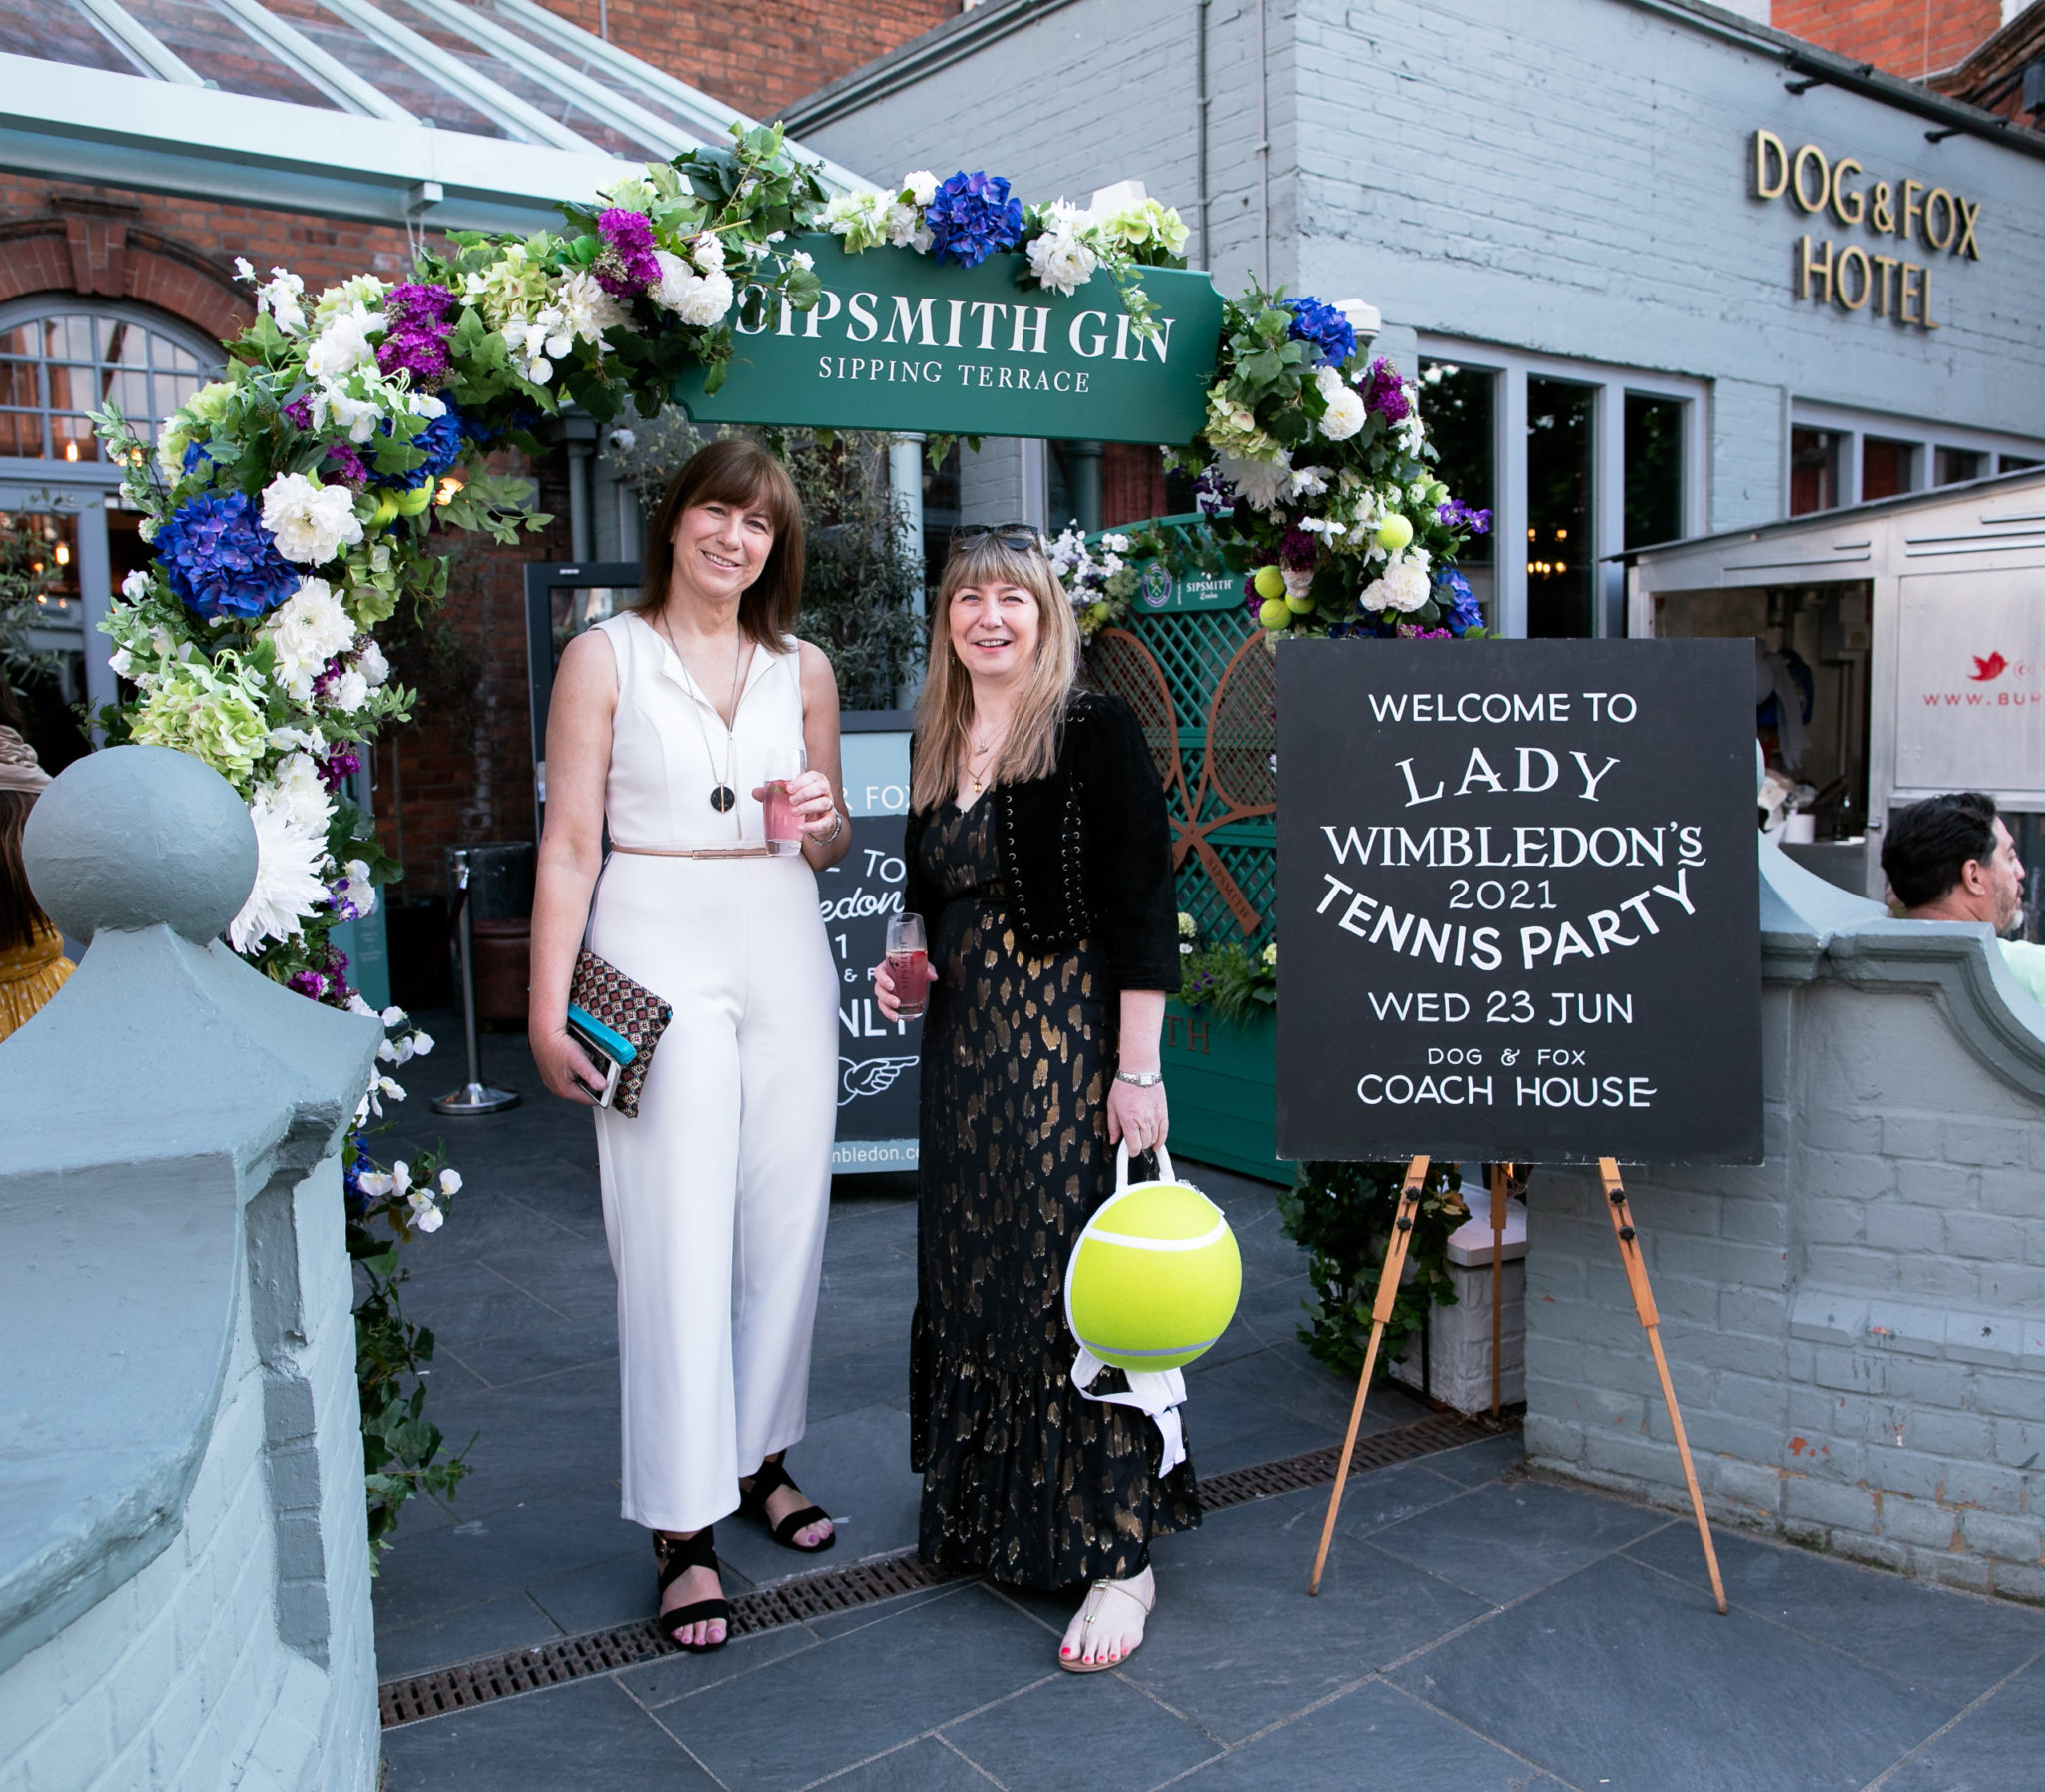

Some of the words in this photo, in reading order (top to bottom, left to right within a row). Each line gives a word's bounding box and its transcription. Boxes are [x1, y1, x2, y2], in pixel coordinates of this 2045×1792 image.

[1800, 234, 1940, 329] HOTEL
[735, 283, 1052, 354] SIPSMITH
[1068, 310, 1176, 364] GIN
[818, 356, 942, 384] SIPPING
[958, 364, 1091, 394] TERRACE
[1186, 579, 1232, 593] SIPSMITH
[1368, 692, 1571, 723] WELCOME
[1582, 691, 1638, 724] TO
[1394, 746, 1621, 807] LADY
[863, 848, 906, 883] TO
[1448, 879, 1557, 910] 2021
[1316, 873, 1502, 971] TENNIS
[1519, 867, 1697, 970] PARTY
[1368, 991, 1471, 1023] WED
[1486, 990, 1535, 1024] 23
[1548, 993, 1633, 1026] JUN
[1428, 1047, 1483, 1066] DOG
[1500, 1047, 1520, 1066] &
[1537, 1049, 1586, 1066] FOX
[1356, 1073, 1493, 1105] COACH
[1516, 1075, 1658, 1108] HOUSE
